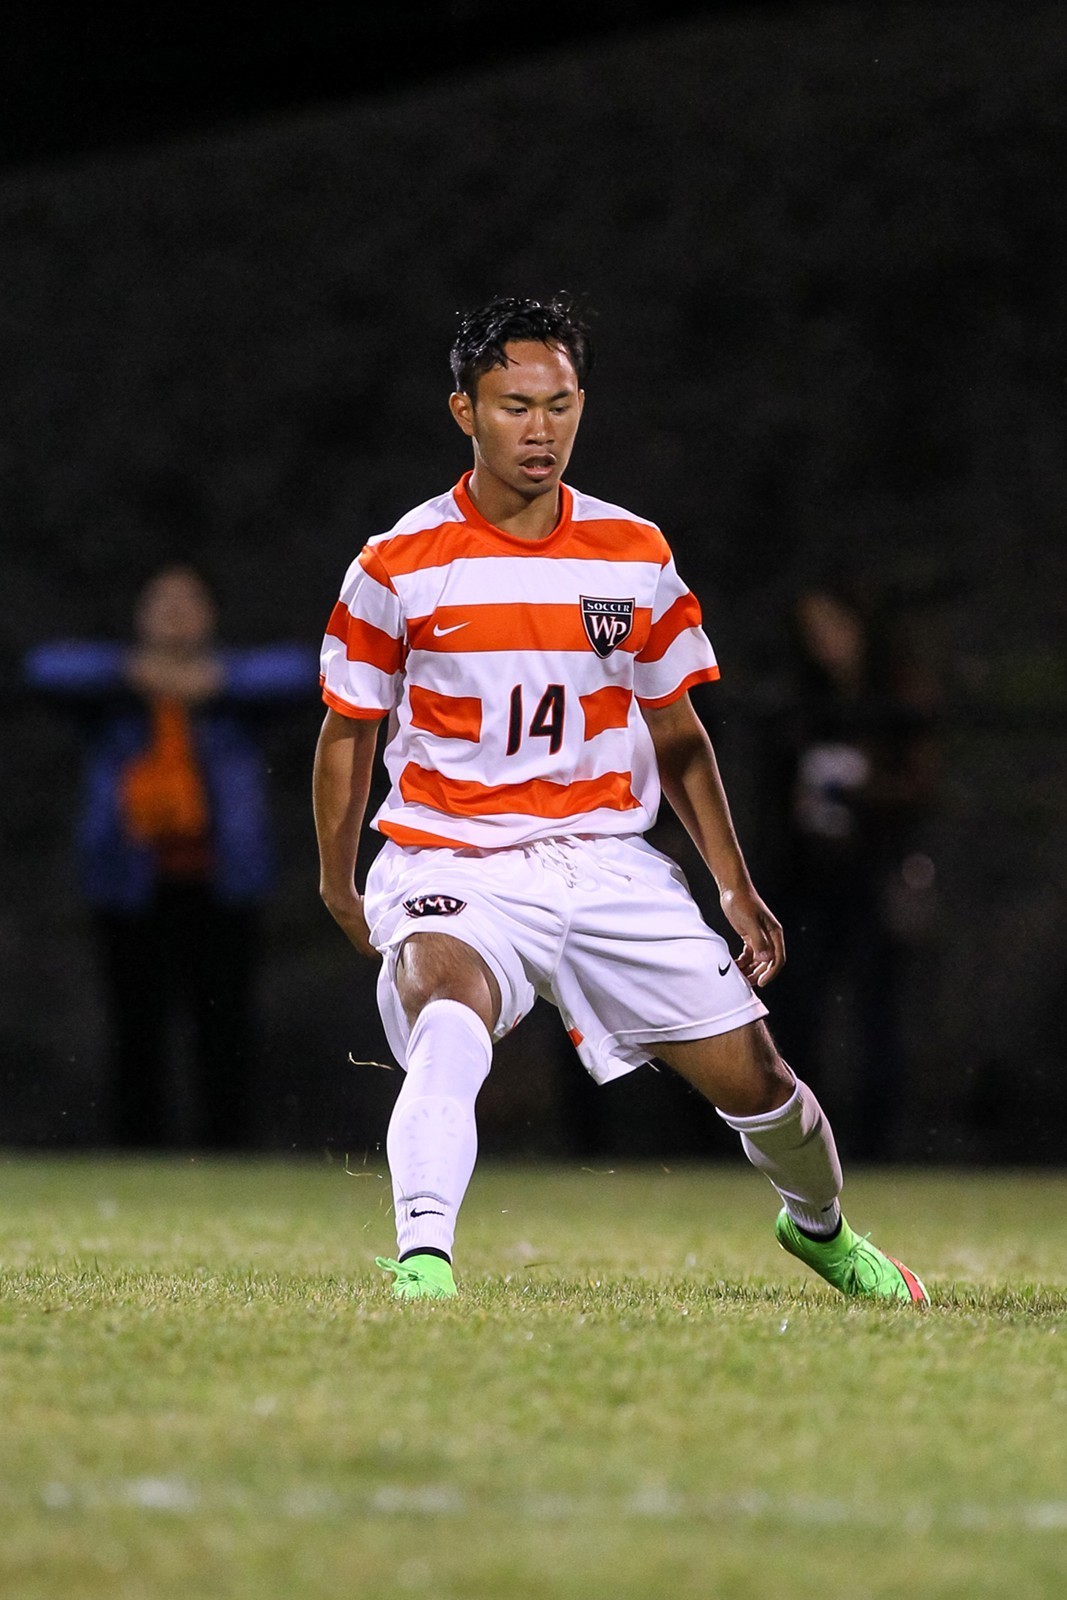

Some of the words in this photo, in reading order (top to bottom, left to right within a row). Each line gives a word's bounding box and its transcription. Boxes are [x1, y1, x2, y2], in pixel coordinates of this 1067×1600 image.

[586, 602, 630, 612] SOCCER
[589, 615, 627, 647] WP
[505, 683, 566, 756] 14
